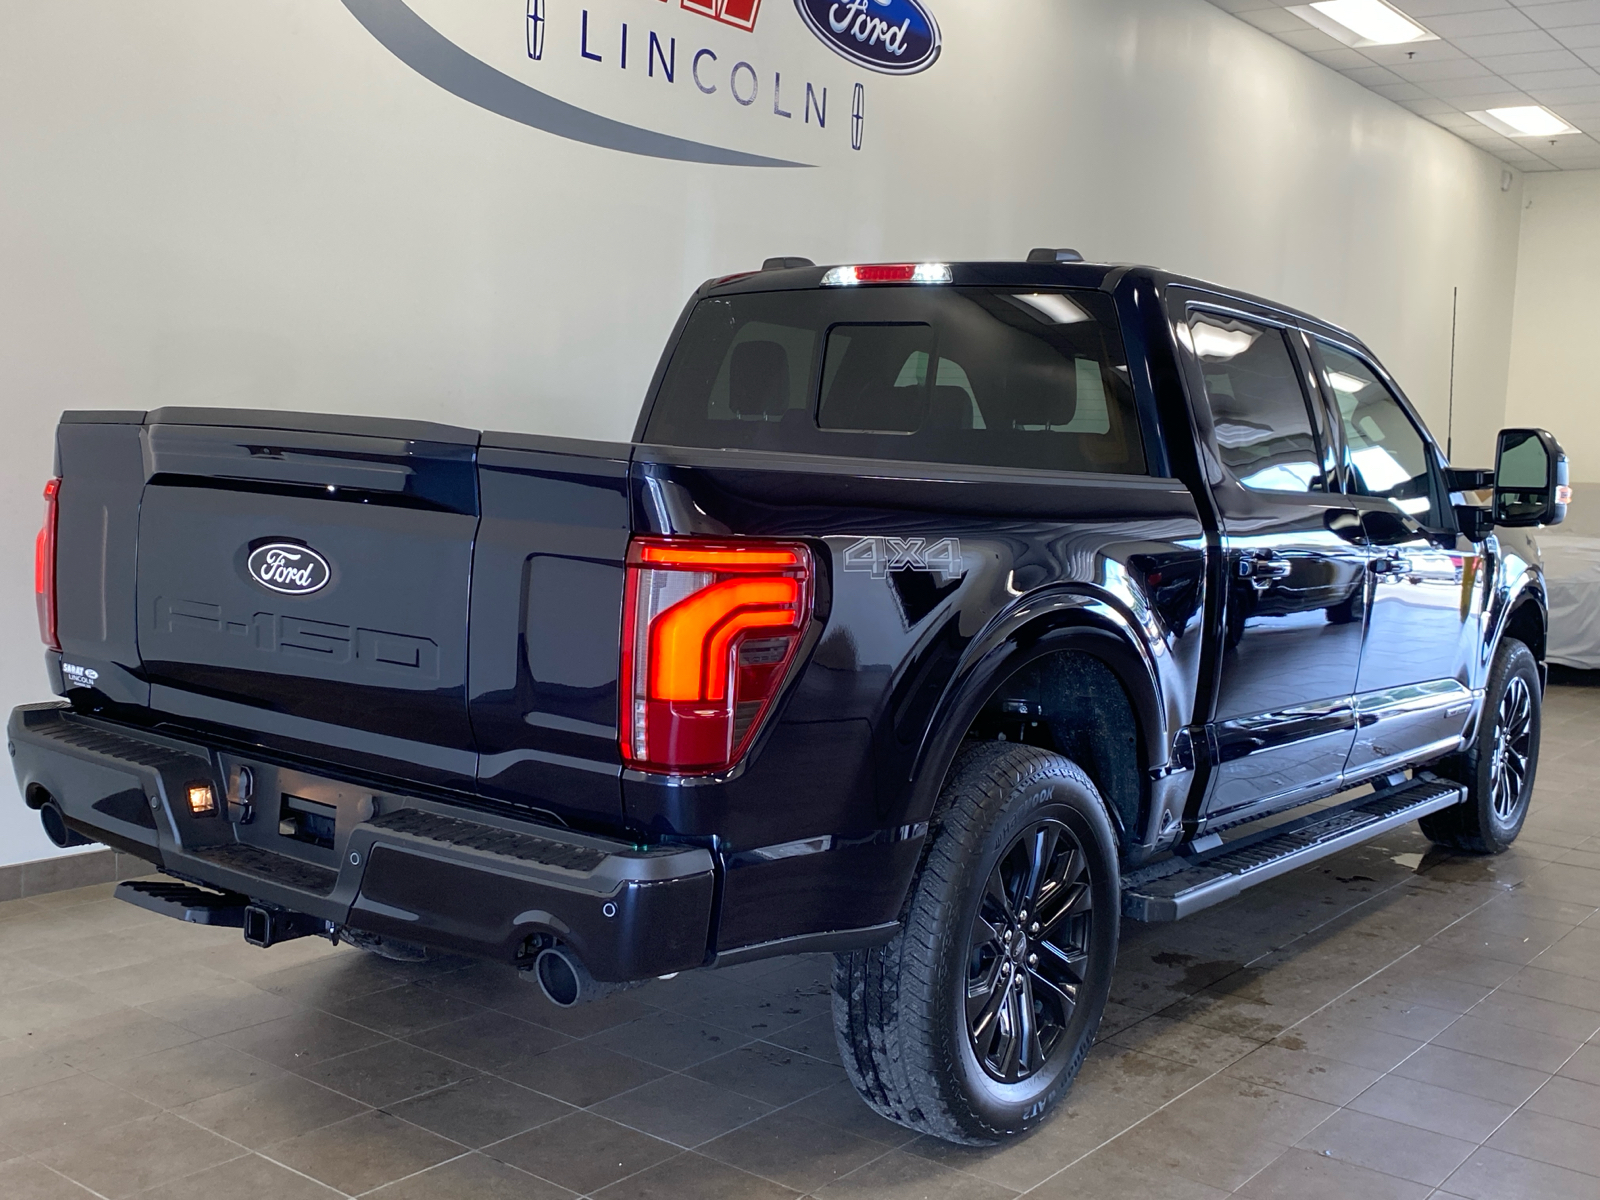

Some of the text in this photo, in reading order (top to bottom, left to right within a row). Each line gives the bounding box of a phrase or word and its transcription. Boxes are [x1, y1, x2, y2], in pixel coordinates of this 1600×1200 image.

[828, 0, 910, 56] Ford
[581, 10, 827, 128] LINCOLN
[260, 548, 315, 587] Ford
[153, 595, 440, 681] F-150
[68, 674, 94, 685] LINCOLN
